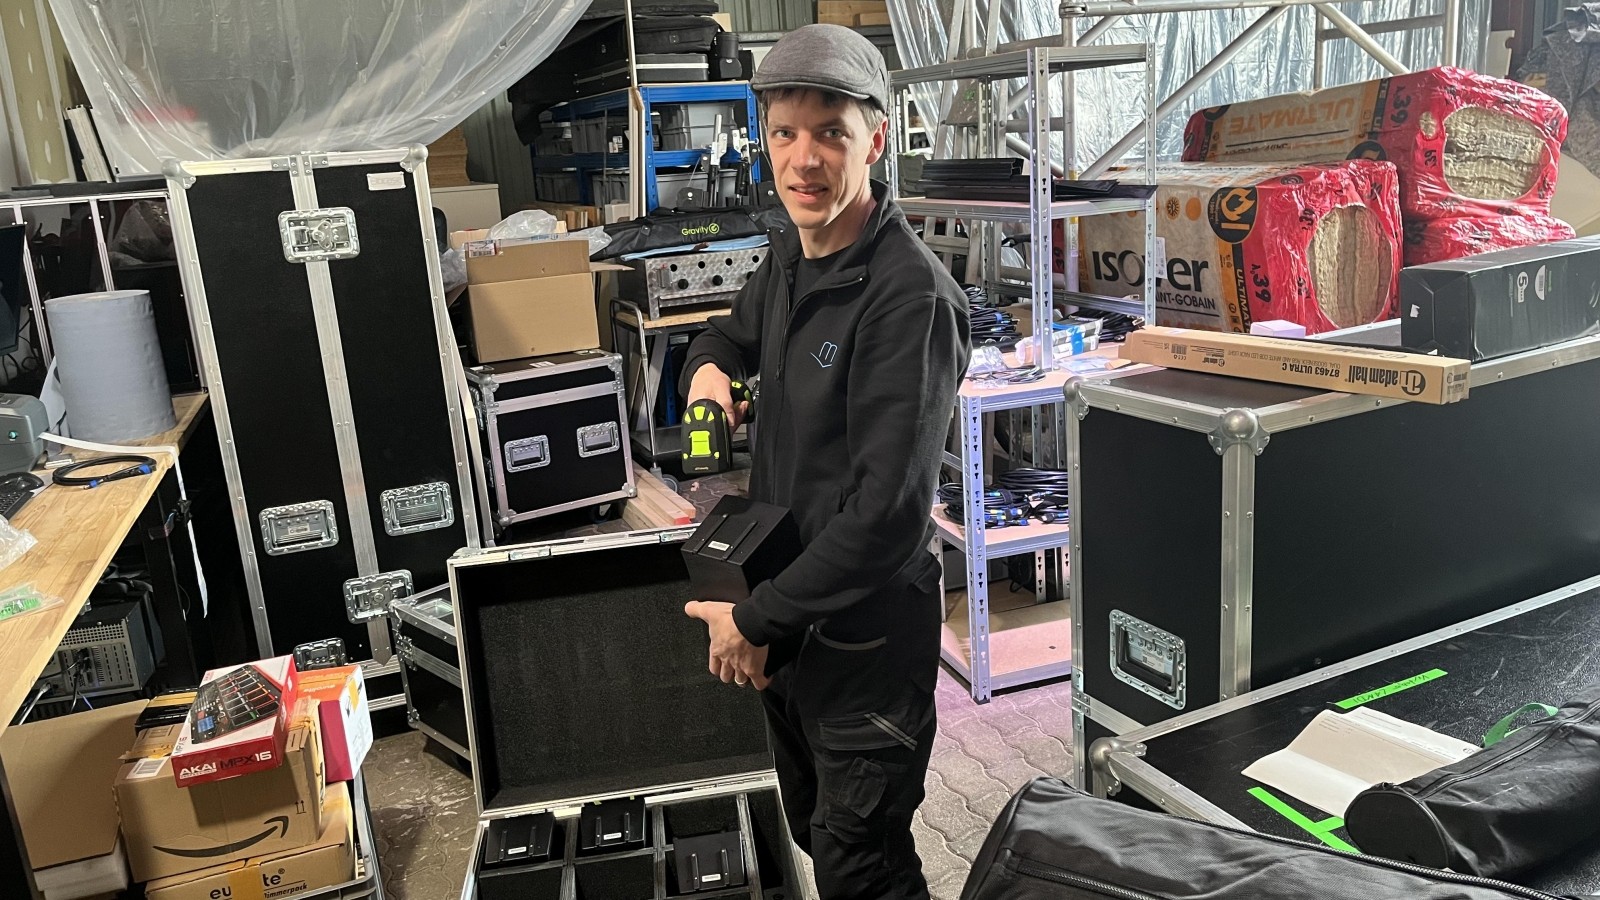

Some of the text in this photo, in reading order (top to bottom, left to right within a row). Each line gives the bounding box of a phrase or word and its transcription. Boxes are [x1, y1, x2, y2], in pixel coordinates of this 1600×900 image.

[1228, 97, 1356, 136] ULTIMATE
[681, 225, 709, 236] Gravity
[1518, 276, 1528, 288] 5
[1281, 362, 1340, 378] 87463 ULTRA C
[1369, 367, 1399, 388] adam
[180, 762, 217, 777] AKAI
[220, 751, 272, 770] MPX16
